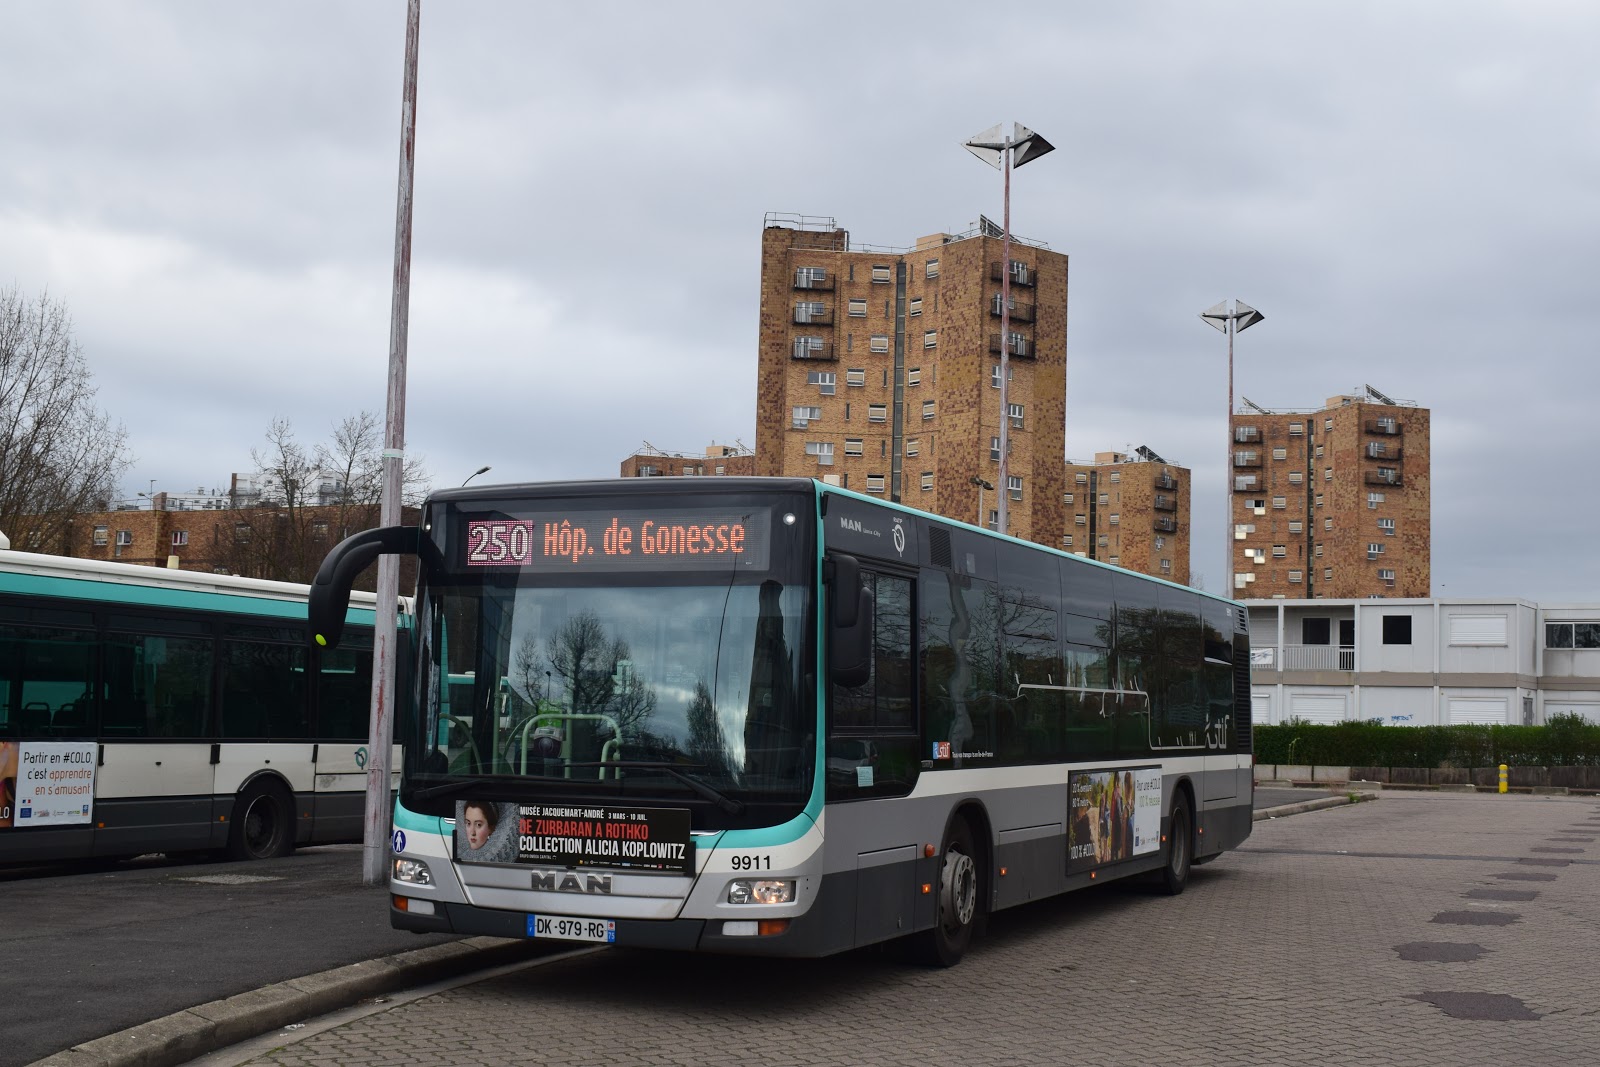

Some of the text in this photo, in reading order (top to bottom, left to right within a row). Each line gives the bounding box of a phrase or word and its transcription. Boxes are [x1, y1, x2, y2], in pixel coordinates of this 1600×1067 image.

[840, 517, 862, 533] MAN
[469, 517, 745, 563] 250 Hôp. de Gonesse
[23, 752, 93, 764] Partir en #COLO,
[49, 768, 92, 782] apprendre
[35, 783, 91, 796] en s'amusant
[519, 805, 541, 816] MUSÉE
[541, 807, 605, 819] JACQUEMART-ANDRÉ
[608, 812, 613, 820] 3
[612, 812, 626, 820] MARS
[630, 812, 636, 821] 10
[636, 813, 648, 821] JUIL.
[519, 819, 533, 835] DE
[535, 820, 592, 837] ZURBARAN
[605, 823, 649, 840] ROTHKO
[519, 835, 685, 860] COLLECTION ALICIA KOPLOWITZ
[731, 855, 771, 870] 9911
[531, 870, 613, 894] MAN
[536, 918, 604, 939] DK-979-RG
[608, 931, 615, 940] 75
